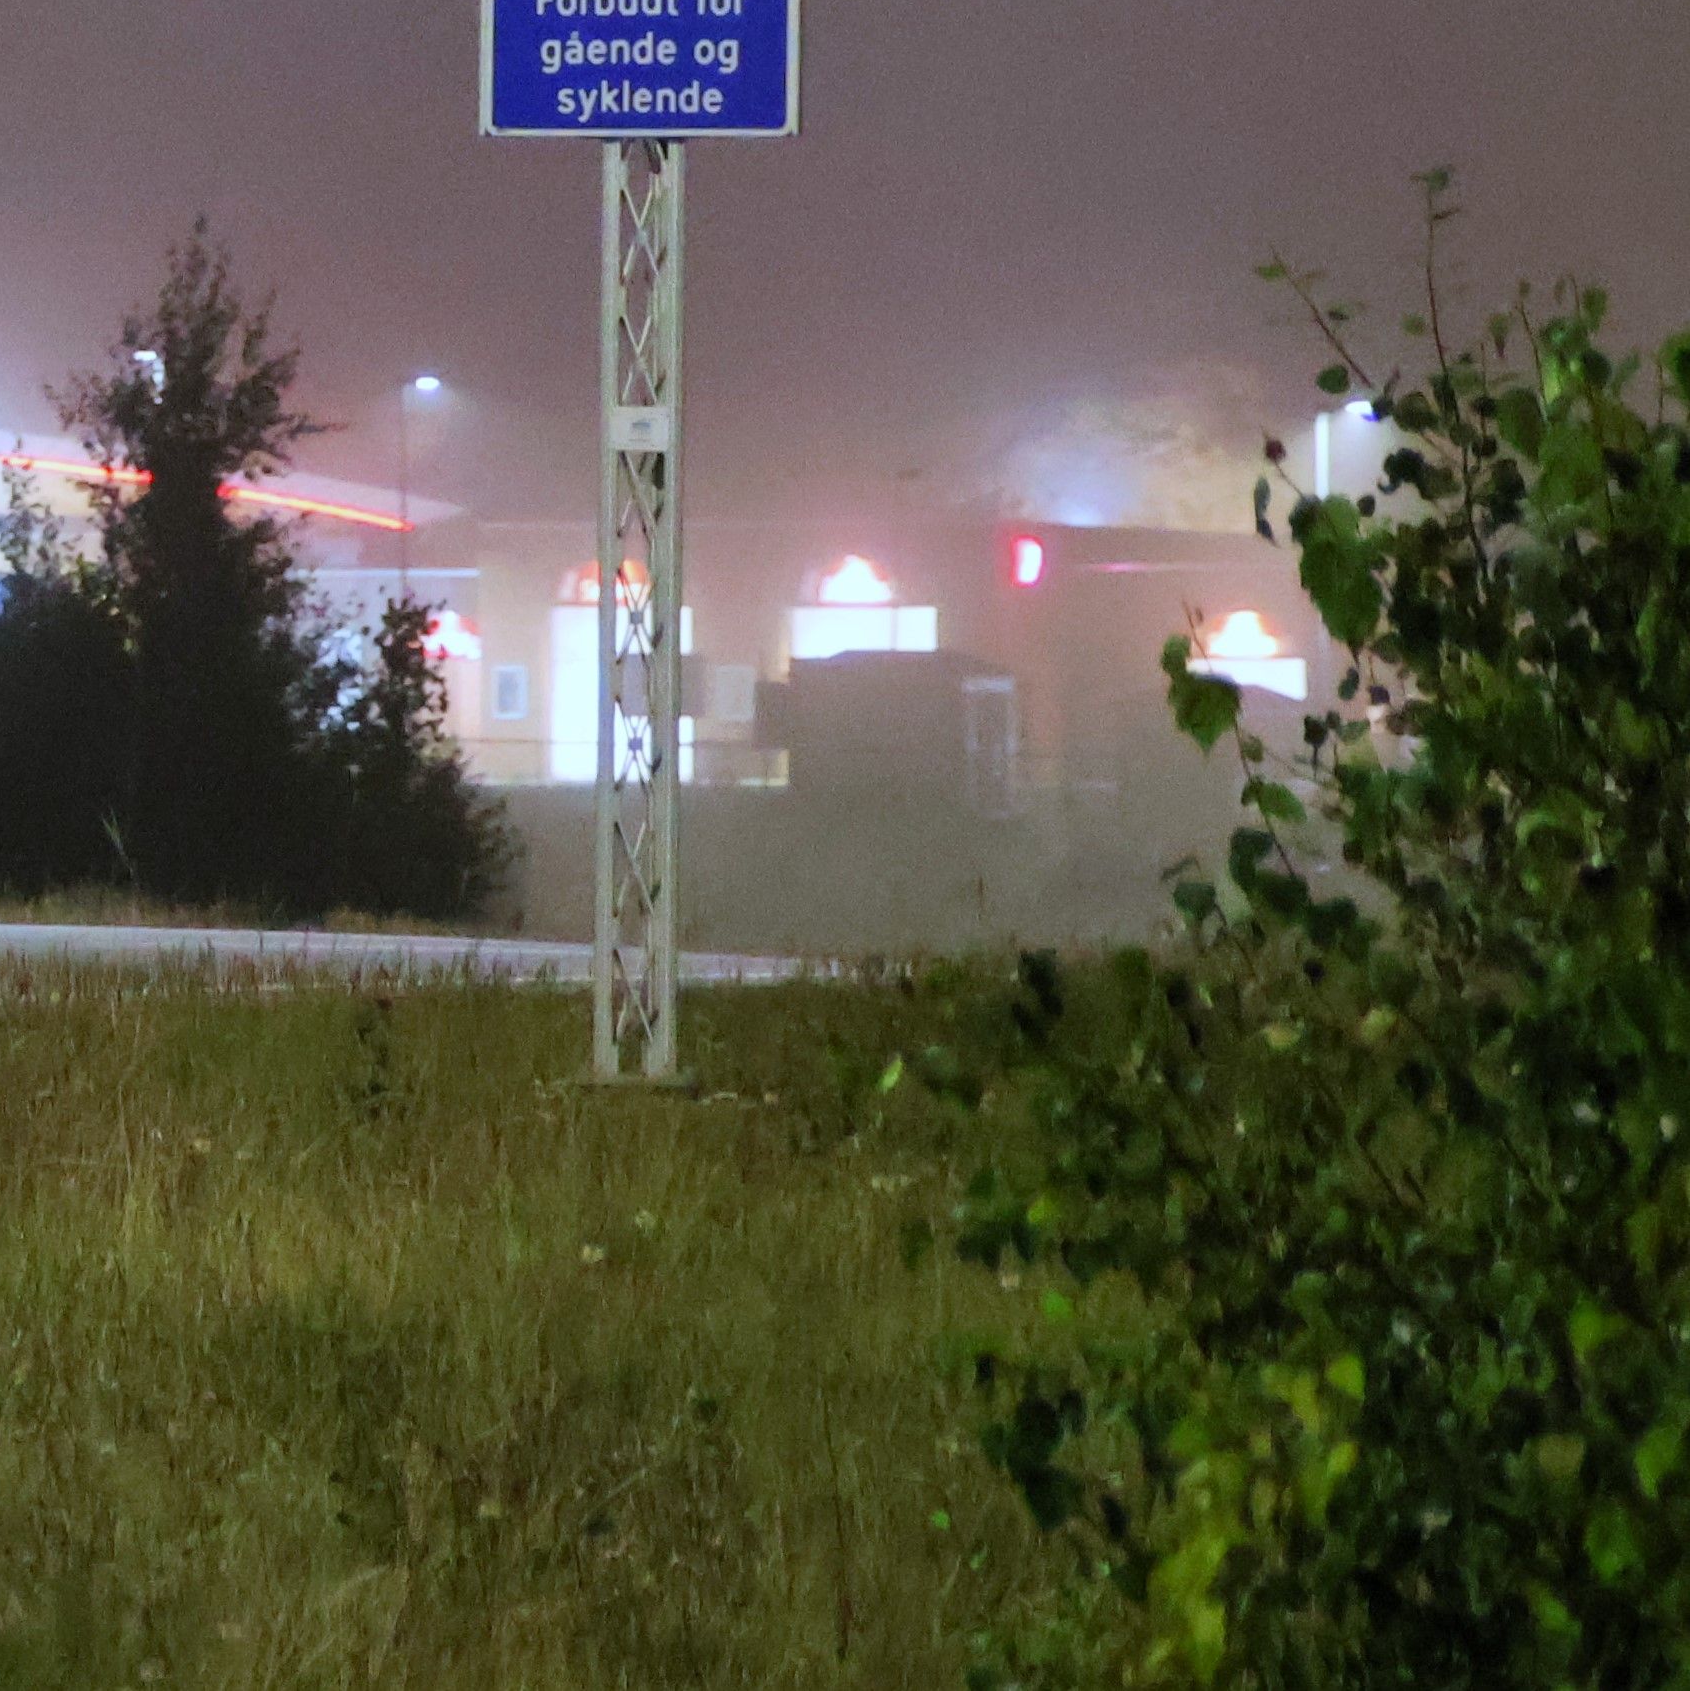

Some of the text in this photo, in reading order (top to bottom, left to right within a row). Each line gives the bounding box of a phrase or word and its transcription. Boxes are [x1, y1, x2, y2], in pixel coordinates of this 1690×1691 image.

[540, 31, 740, 74] gående og
[557, 80, 724, 123] syklende
